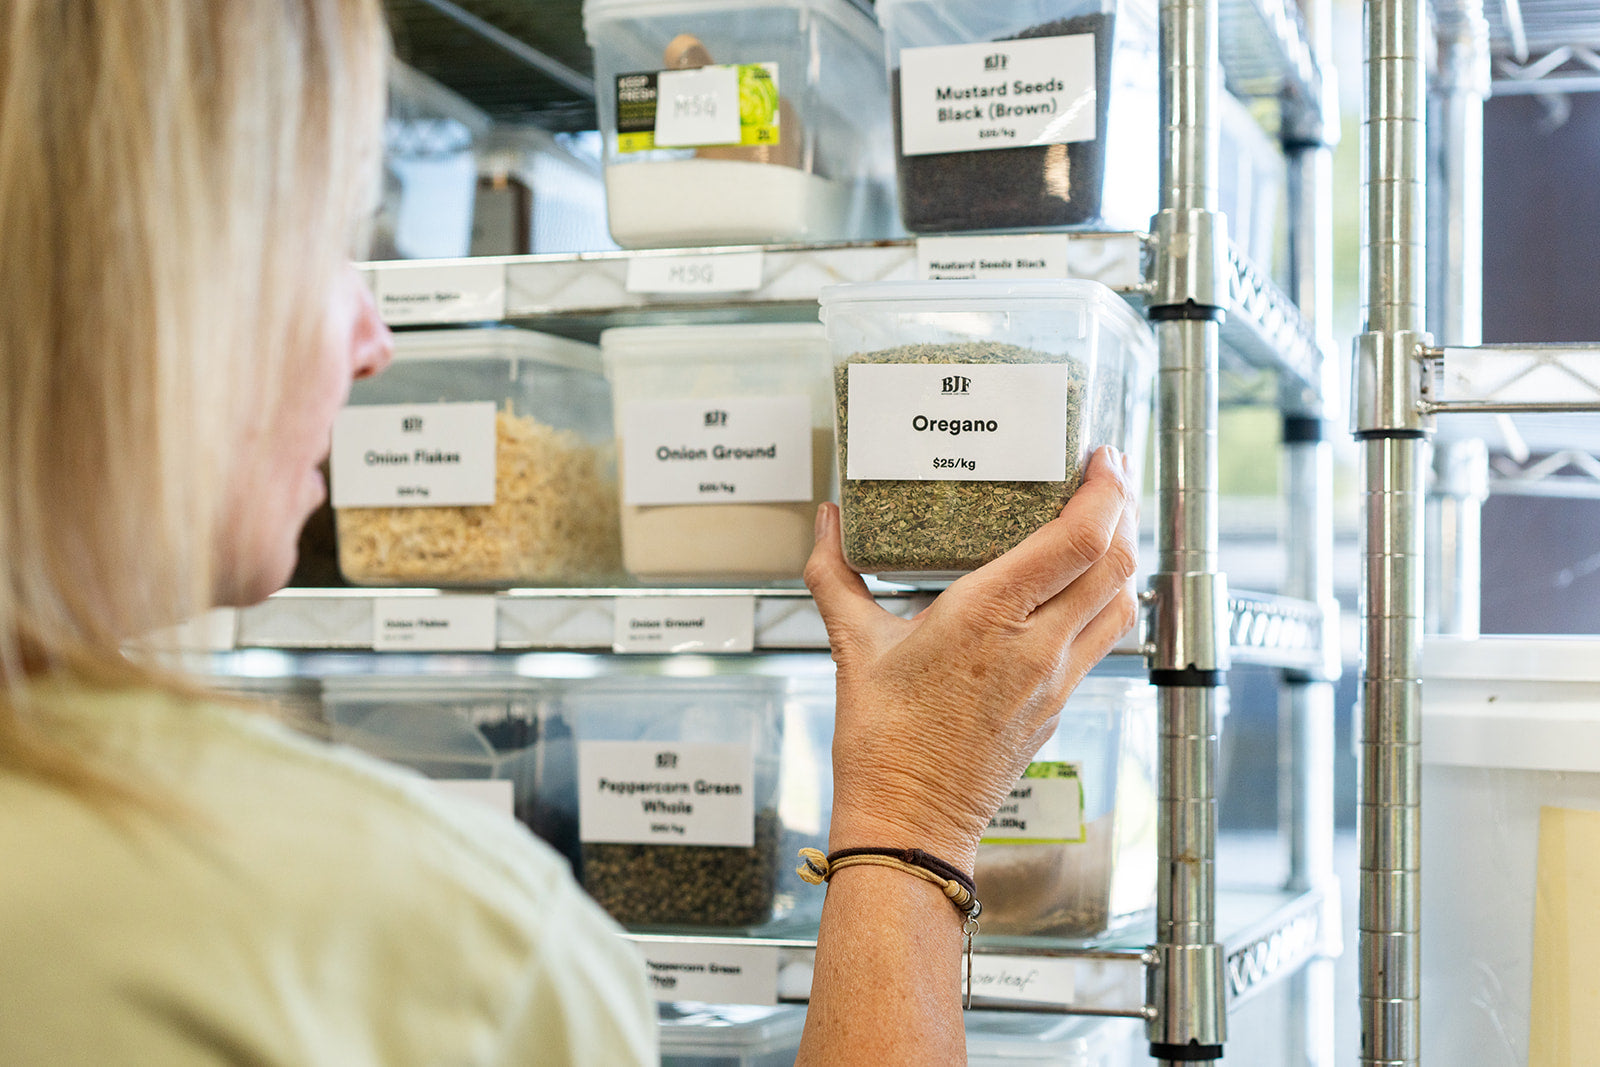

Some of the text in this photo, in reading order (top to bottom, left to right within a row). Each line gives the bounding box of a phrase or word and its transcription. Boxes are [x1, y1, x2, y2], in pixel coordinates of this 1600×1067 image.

[936, 78, 1064, 100] Mustard Seeds
[938, 98, 1057, 122] Black (Brown)
[930, 259, 1046, 270] Mustard Seeds Black
[941, 376, 971, 393] BJF
[912, 415, 998, 436] Oregano
[365, 449, 460, 466] Onion Flakes
[656, 443, 777, 460] Onion Ground
[933, 457, 976, 470] $25/kg
[599, 778, 742, 795] Peppercorn Green
[642, 801, 693, 814] Whole
